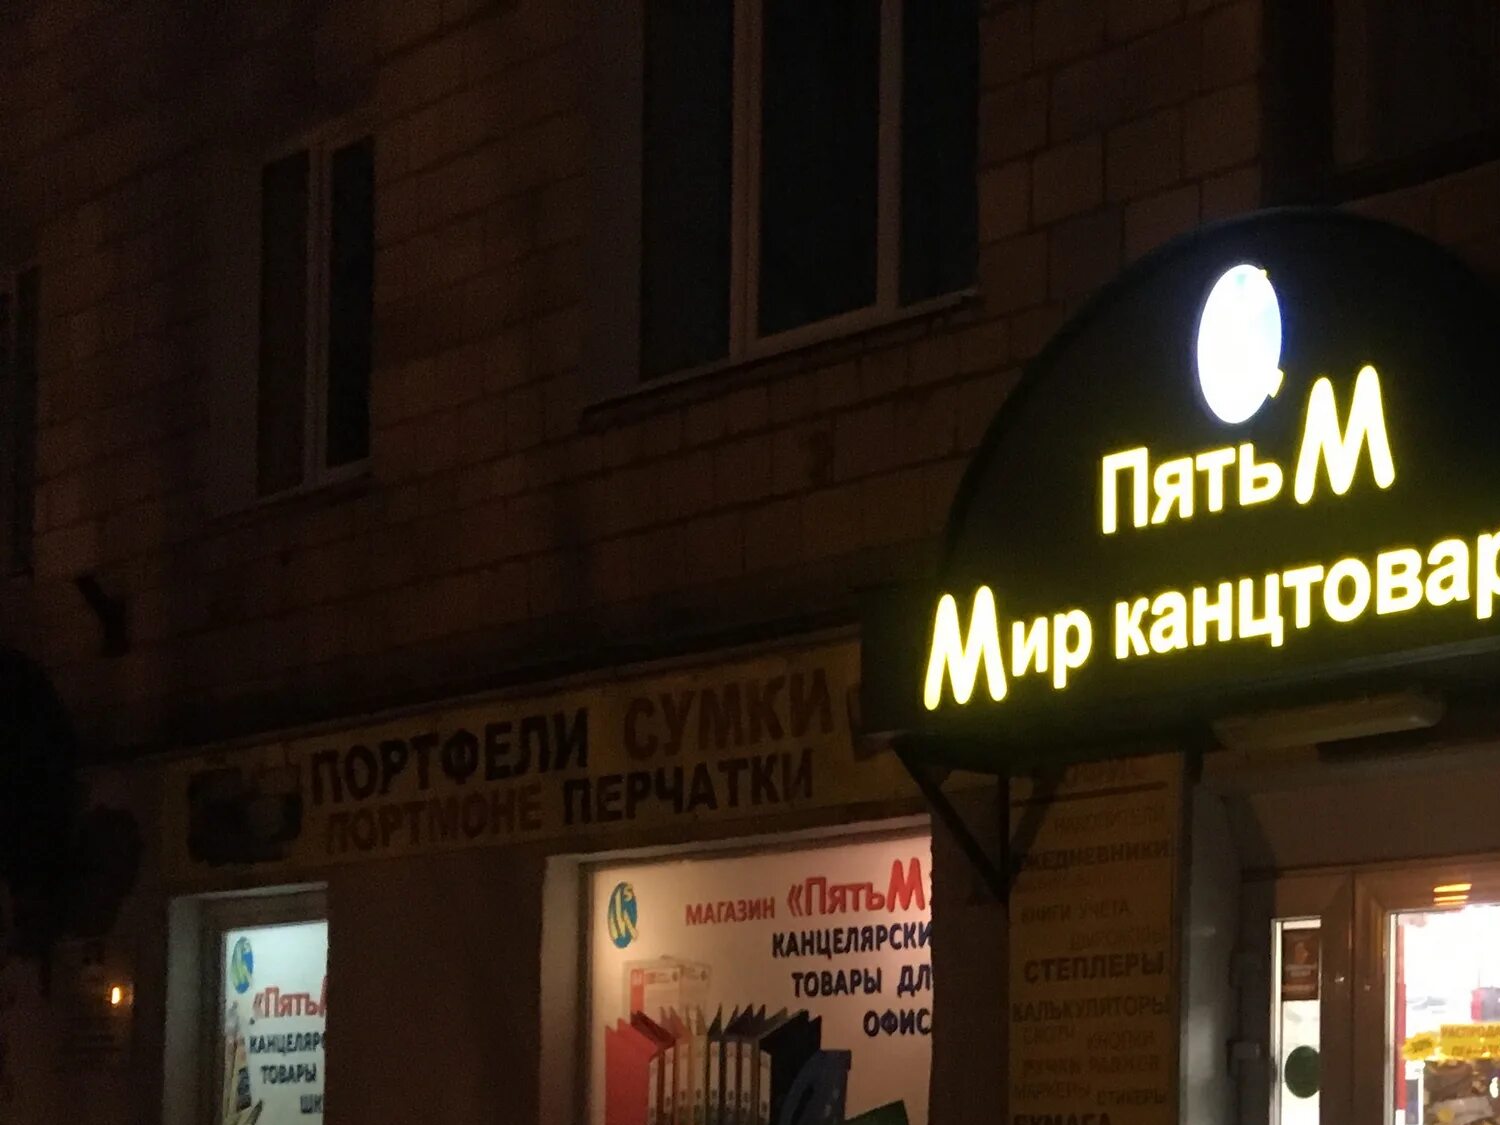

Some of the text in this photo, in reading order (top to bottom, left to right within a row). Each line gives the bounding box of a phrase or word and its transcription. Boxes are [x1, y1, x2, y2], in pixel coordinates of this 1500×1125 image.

[923, 585, 1094, 711] Мир
[311, 667, 836, 807] ПОРТФЕЛИ СУМКИ
[325, 748, 815, 855] ПОРТМОНЕ ПЕРЧАТКИ
[686, 857, 934, 927] МАГАЗИН «ПятьМ
[1021, 904, 1071, 924] КНИГИ
[771, 920, 933, 960] КАНЦЕЛЯРСКИ
[791, 961, 933, 999] ТОВАРЫ ДЛ
[1024, 951, 1165, 984] СТЕПЛЕРЫ
[863, 1006, 934, 1038] ОФИС
[1012, 994, 1170, 1024] КАЛЬКУЛЯТОРЫ
[1086, 1030, 1157, 1051] КНОПКИ
[260, 1063, 318, 1085] ТОВАРЫ
[1097, 1087, 1167, 1107] СТИКЕРЫ
